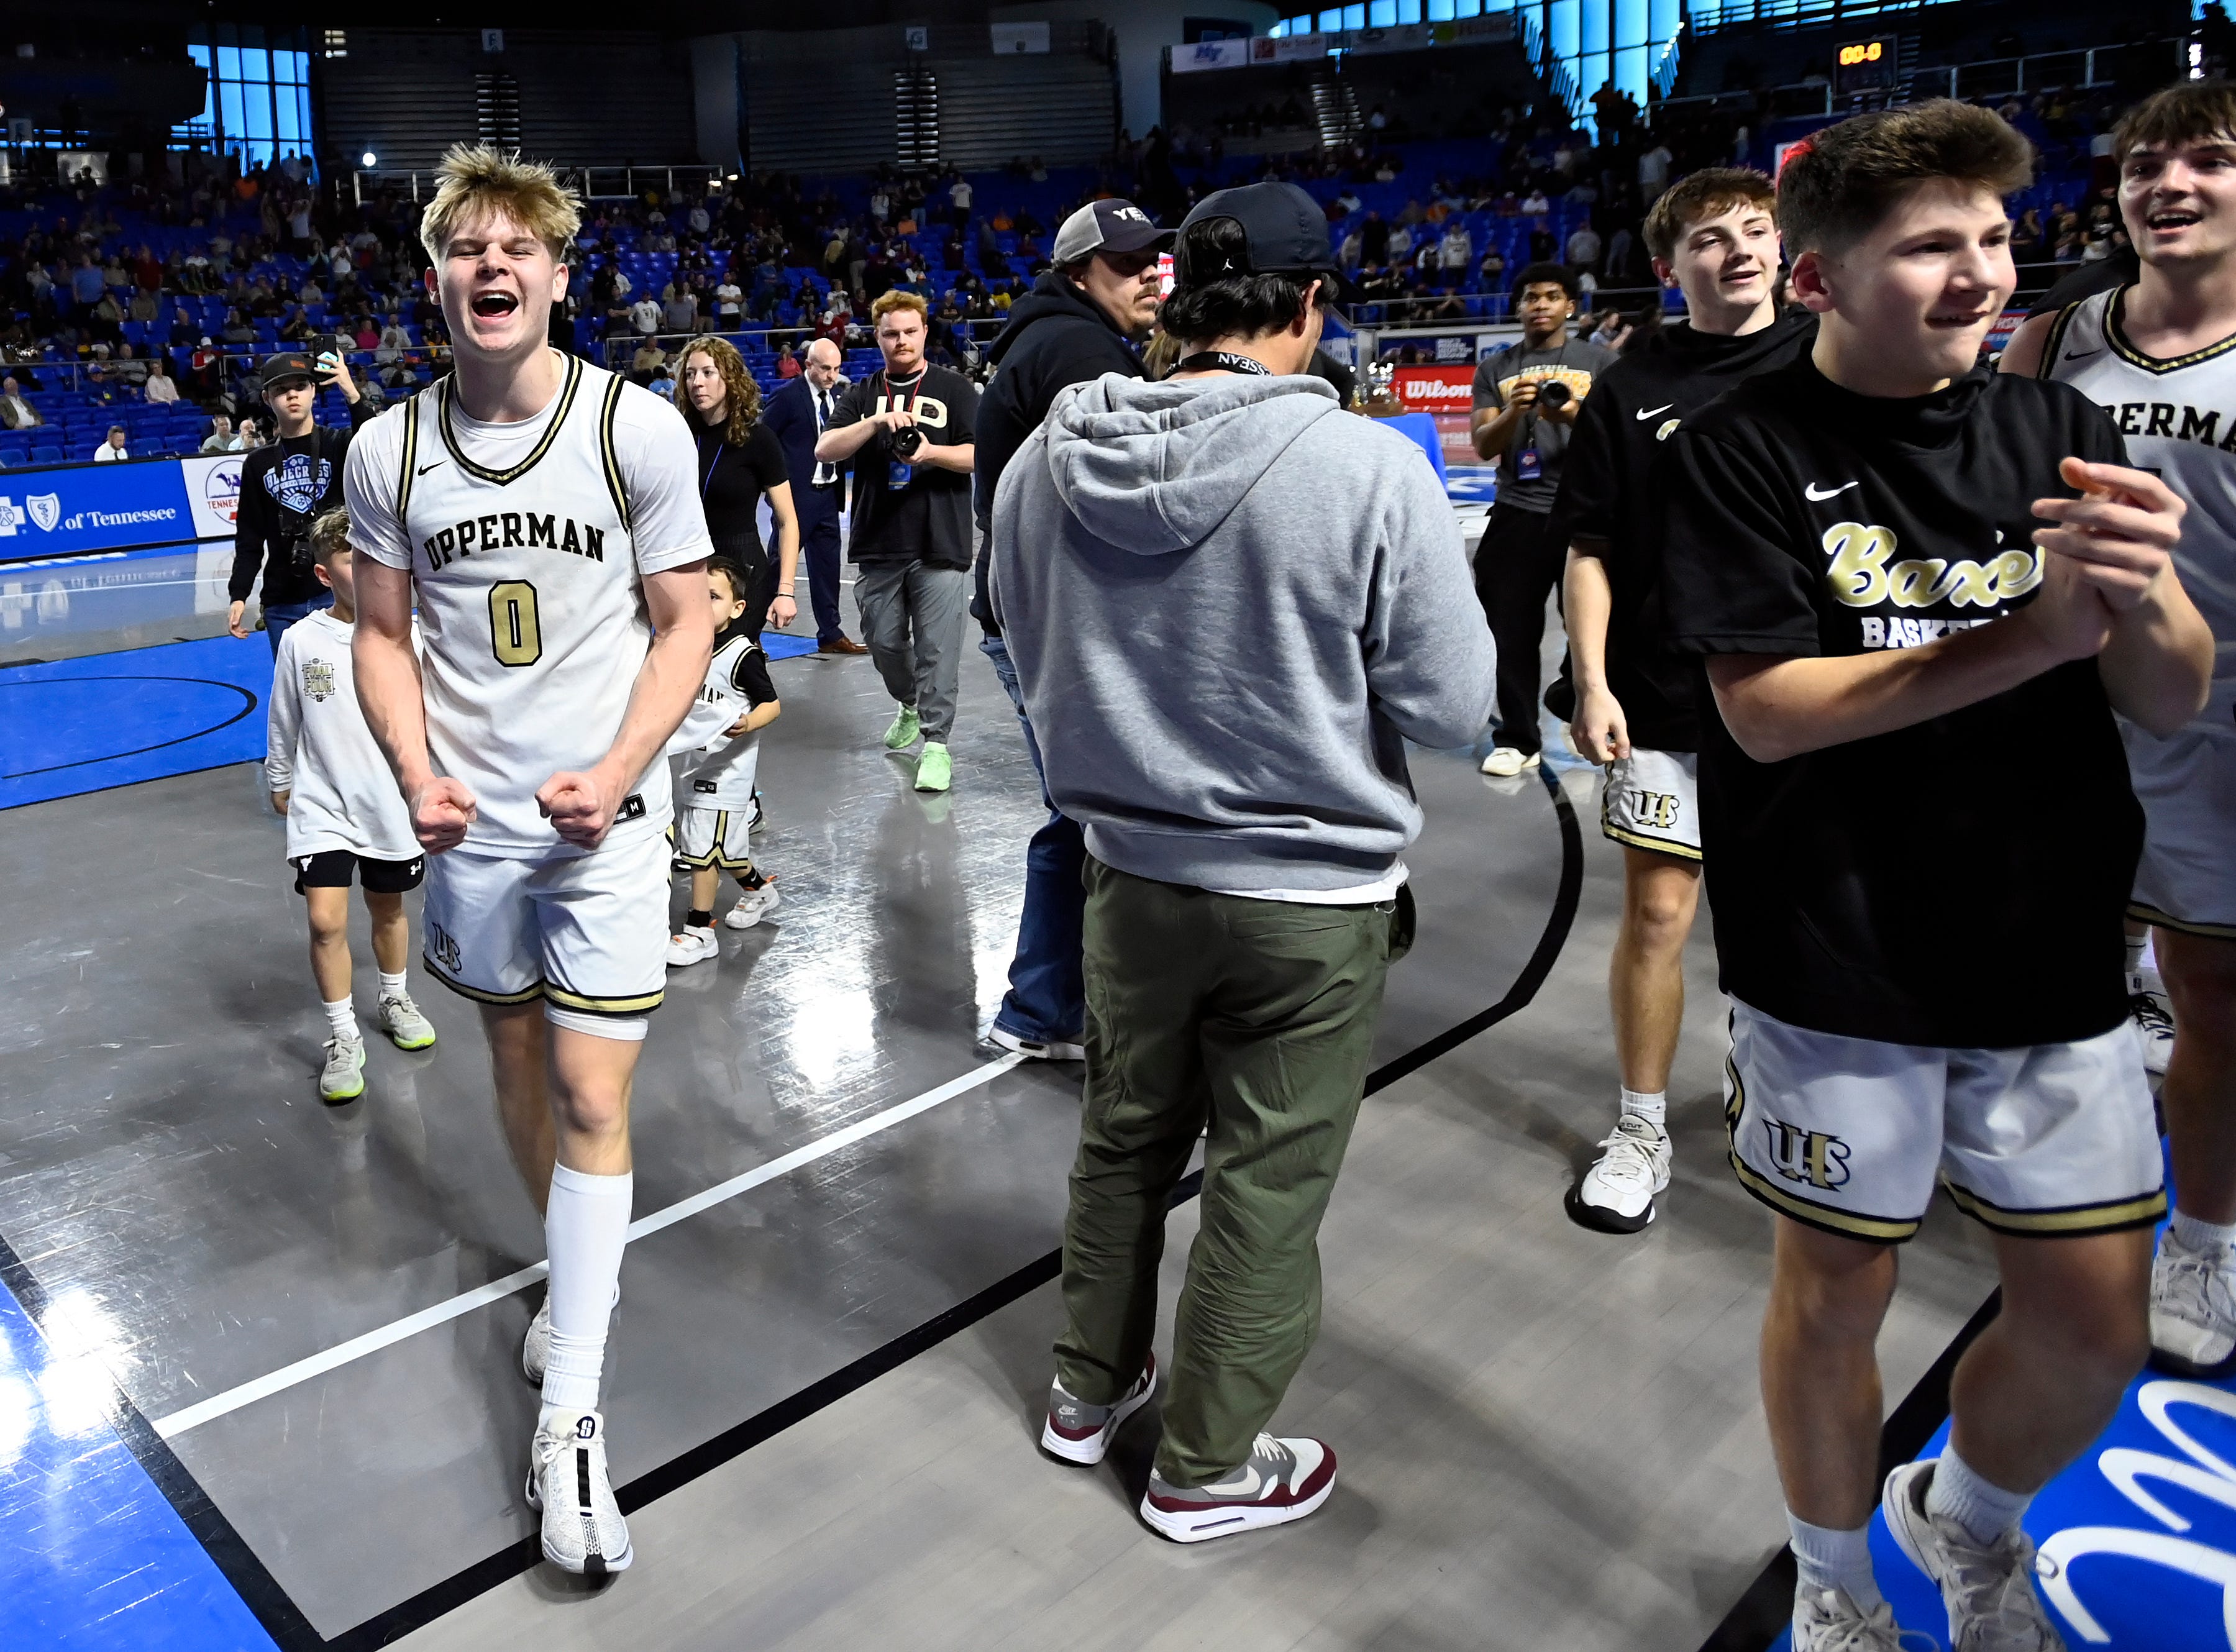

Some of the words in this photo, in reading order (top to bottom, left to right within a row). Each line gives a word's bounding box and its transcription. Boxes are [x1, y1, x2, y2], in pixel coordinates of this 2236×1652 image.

[1218, 353, 1273, 376] SSEAN
[1405, 380, 1472, 398] Wilson
[267, 465, 329, 489] BLUECRSS
[65, 513, 83, 530] of
[86, 508, 176, 527] Tennessee
[424, 513, 604, 572] UPPERMAN
[488, 579, 542, 667] 0
[629, 801, 639, 813] M
